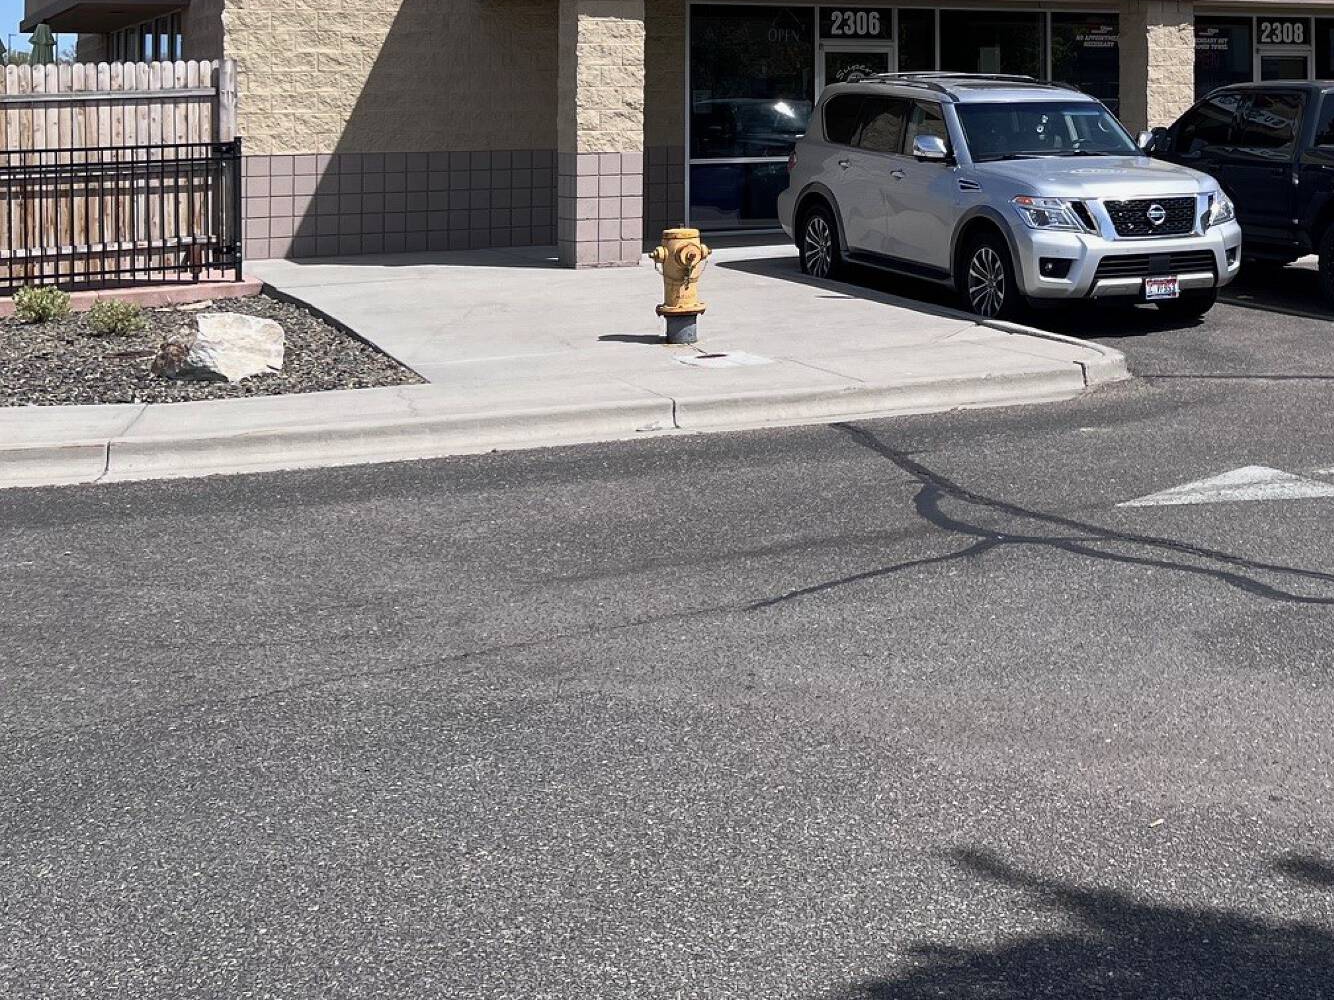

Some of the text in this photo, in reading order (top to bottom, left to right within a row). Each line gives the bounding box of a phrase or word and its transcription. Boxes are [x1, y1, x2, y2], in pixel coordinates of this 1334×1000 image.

[830, 10, 881, 36] 2306
[1260, 21, 1304, 45] 2308
[835, 63, 877, 80] Super
